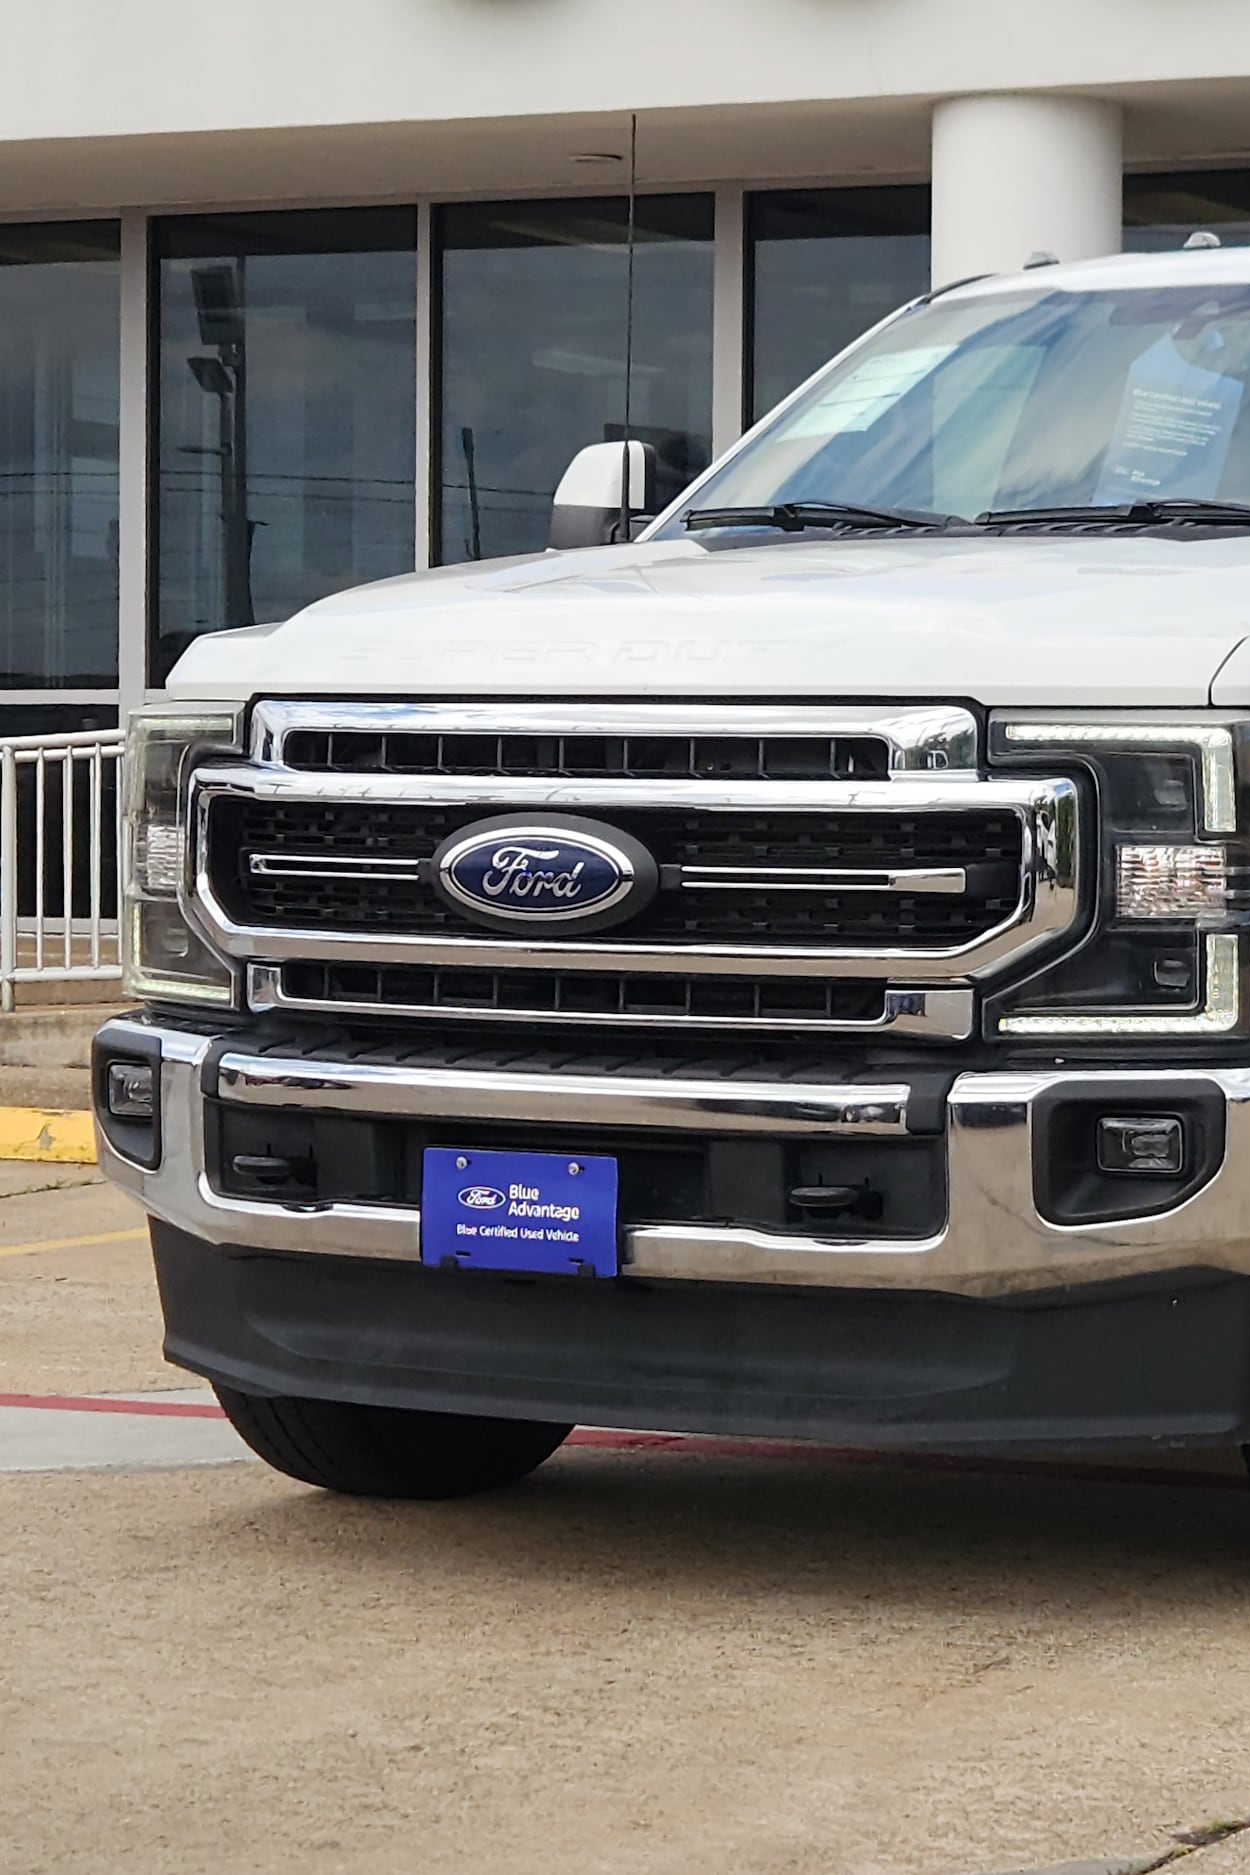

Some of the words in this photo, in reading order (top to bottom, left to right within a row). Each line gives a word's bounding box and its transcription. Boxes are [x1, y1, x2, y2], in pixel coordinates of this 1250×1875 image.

[338, 637, 598, 665] SUPER
[482, 846, 585, 898] Ford
[466, 1189, 497, 1206] Ford
[509, 1184, 539, 1200] Blue
[508, 1202, 579, 1221] Advantage
[456, 1223, 477, 1236] Blue
[479, 1226, 518, 1239] Certified
[520, 1227, 544, 1241] Used
[545, 1229, 580, 1243] Vehicle
